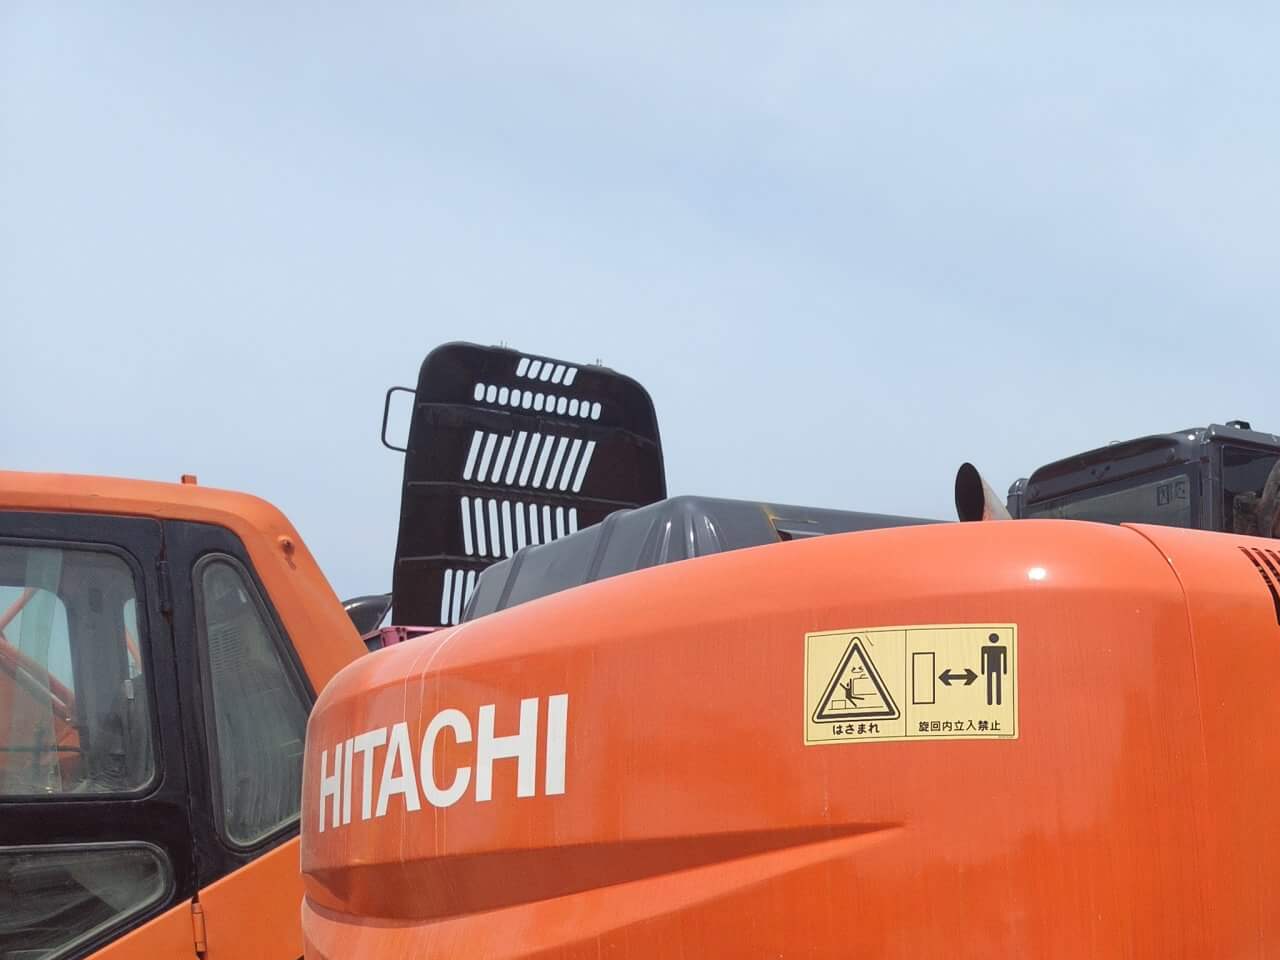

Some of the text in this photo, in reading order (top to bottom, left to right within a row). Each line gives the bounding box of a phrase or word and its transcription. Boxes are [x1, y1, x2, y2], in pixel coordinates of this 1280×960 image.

[833, 722, 880, 735] はさまれ
[918, 720, 1001, 732] 旋回内立入禁止
[319, 693, 569, 832] HITACHI
